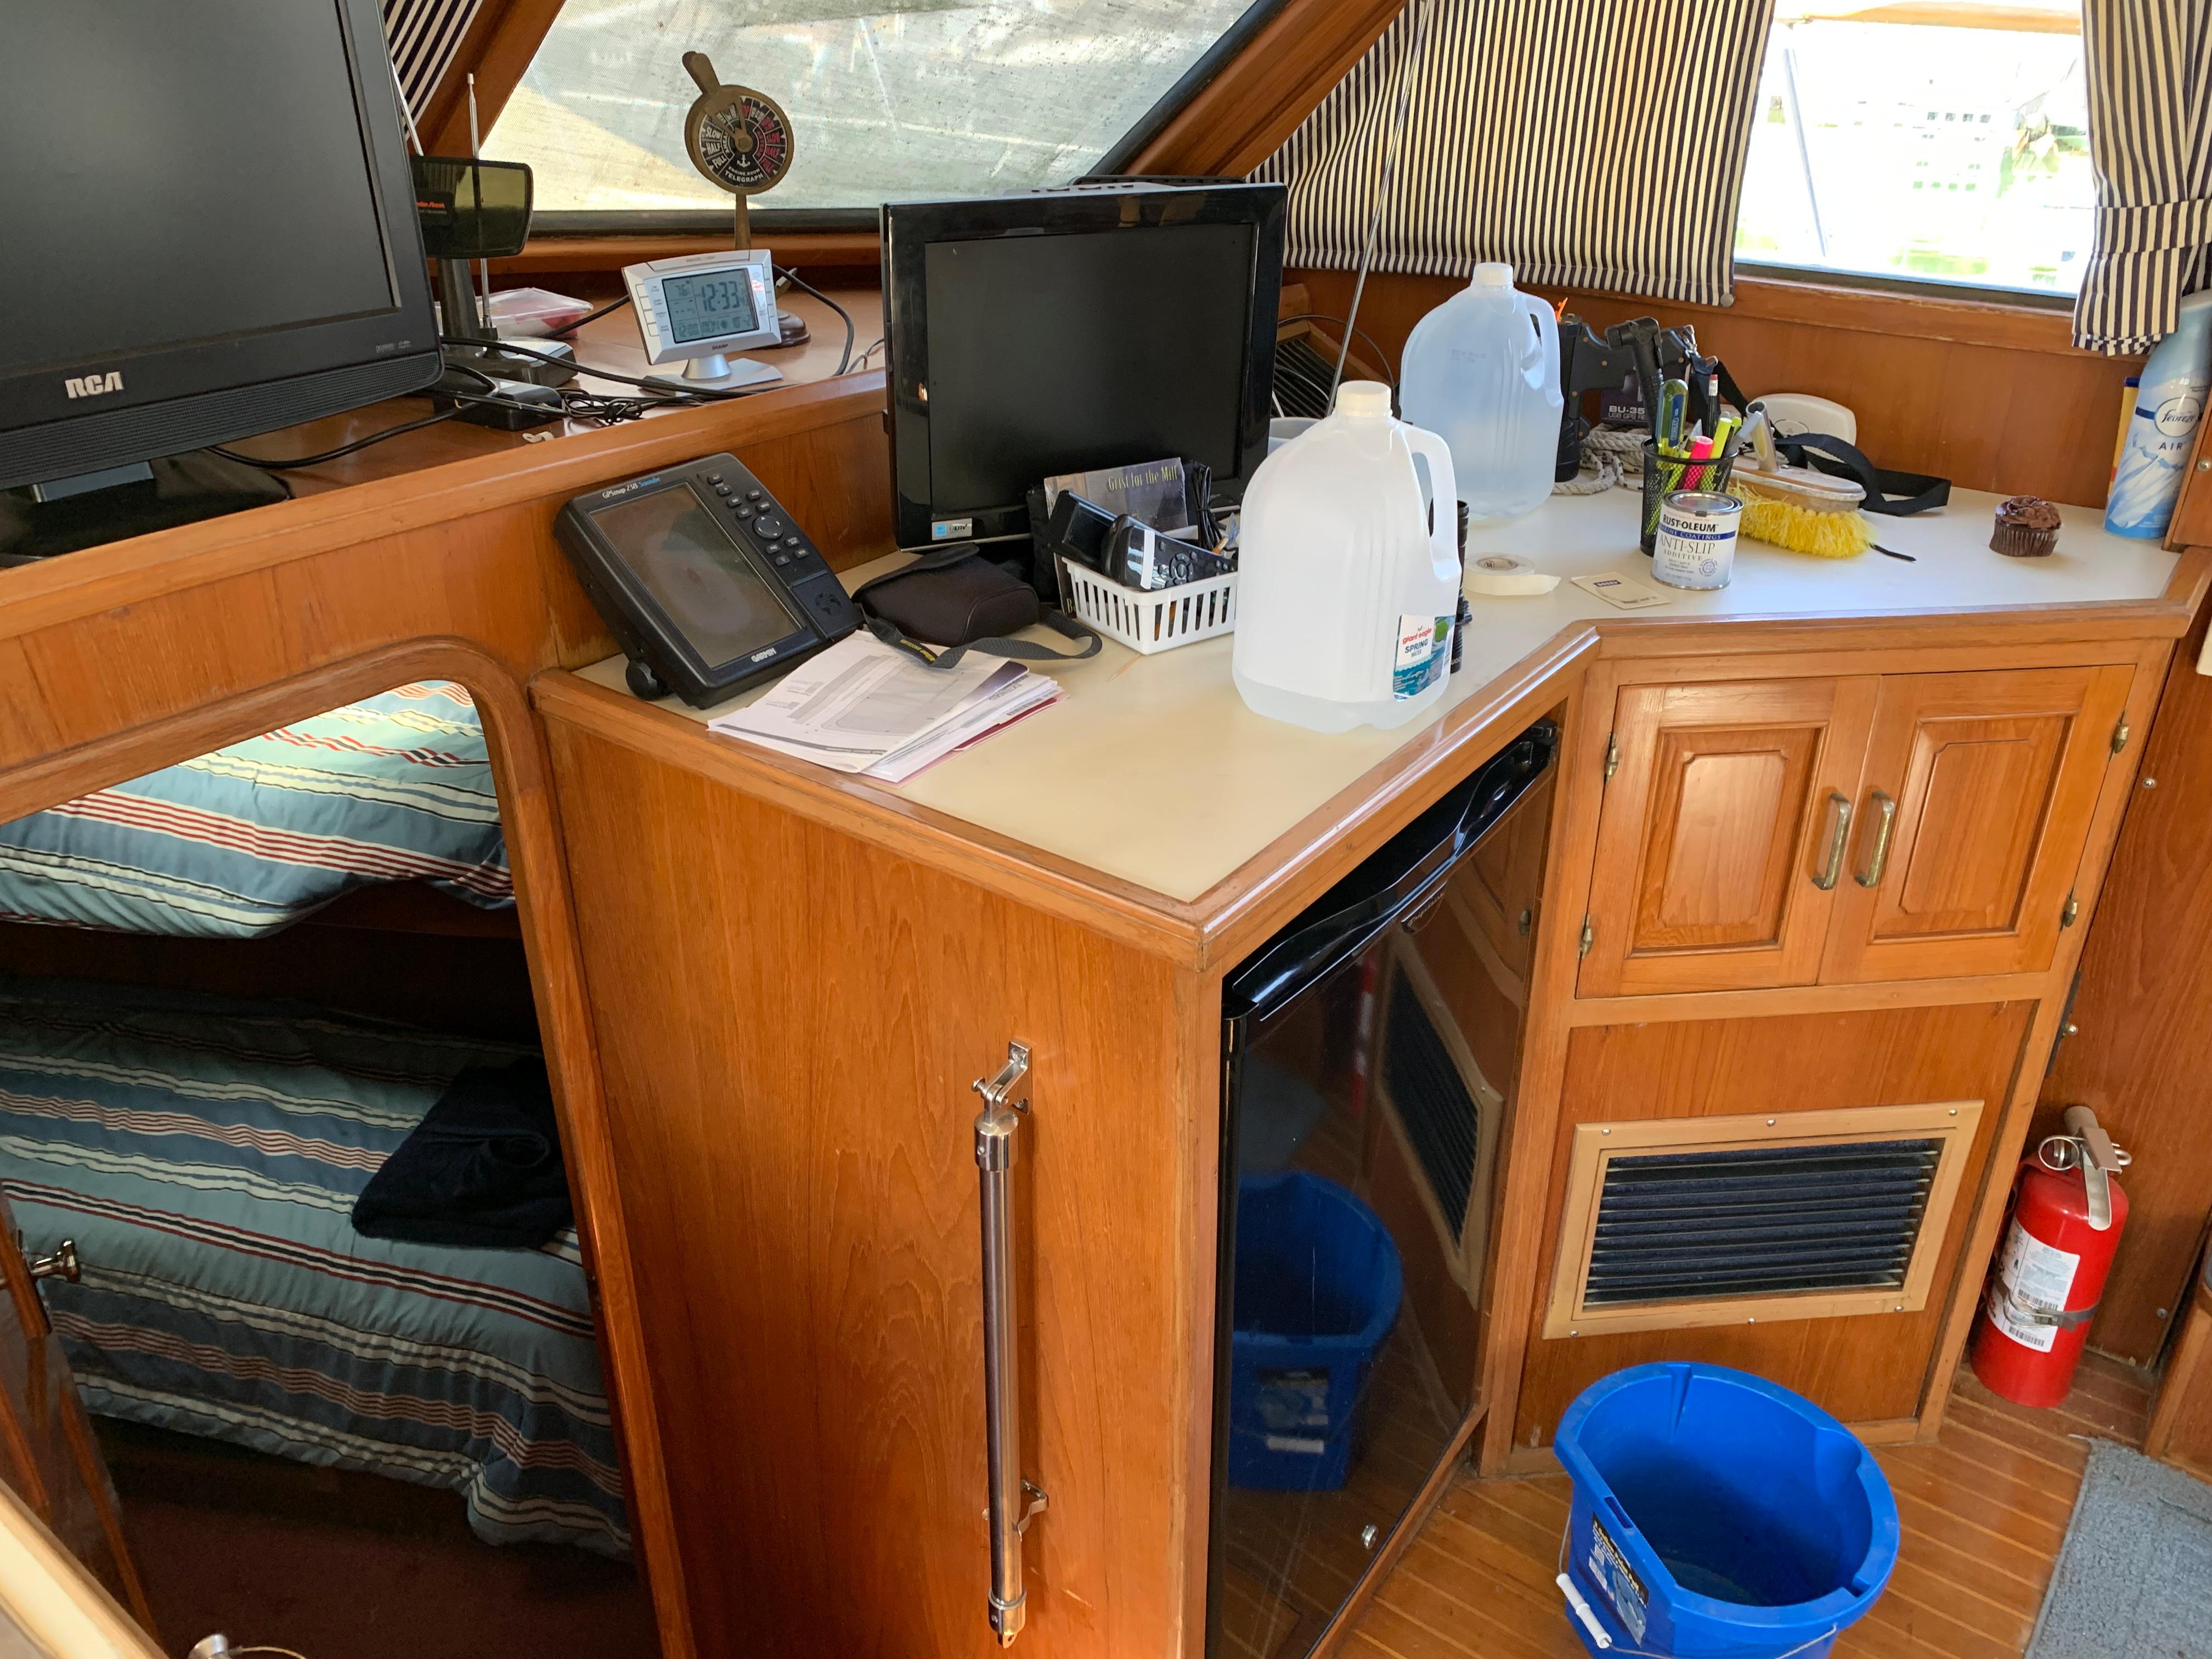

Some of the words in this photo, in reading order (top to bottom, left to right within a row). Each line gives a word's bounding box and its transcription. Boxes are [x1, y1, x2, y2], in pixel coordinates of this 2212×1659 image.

[706, 126, 721, 139] SLOW
[706, 143, 721, 155] HALF
[712, 155, 727, 169] FULL
[724, 170, 764, 183] TELEGRAPH
[701, 280, 740, 312] 12:33
[65, 371, 124, 399] RCA
[1609, 405, 1645, 414] BU-35
[2159, 442, 2183, 450] AIR
[1108, 476, 1129, 491] Grist
[1131, 472, 1142, 487] for
[1146, 470, 1159, 484] the
[1161, 465, 1177, 482] Mill
[602, 488, 626, 498] GPSmap
[1659, 524, 1677, 535] ARINE
[1680, 531, 1721, 540] COATINGS
[1659, 534, 1716, 554] ANTI-SLIP
[1663, 549, 1702, 561] ADDITIVE
[1402, 633, 1418, 645] giant
[1418, 628, 1432, 637] eagle
[1404, 639, 1428, 653] SPRING
[751, 647, 777, 663] GARMIN
